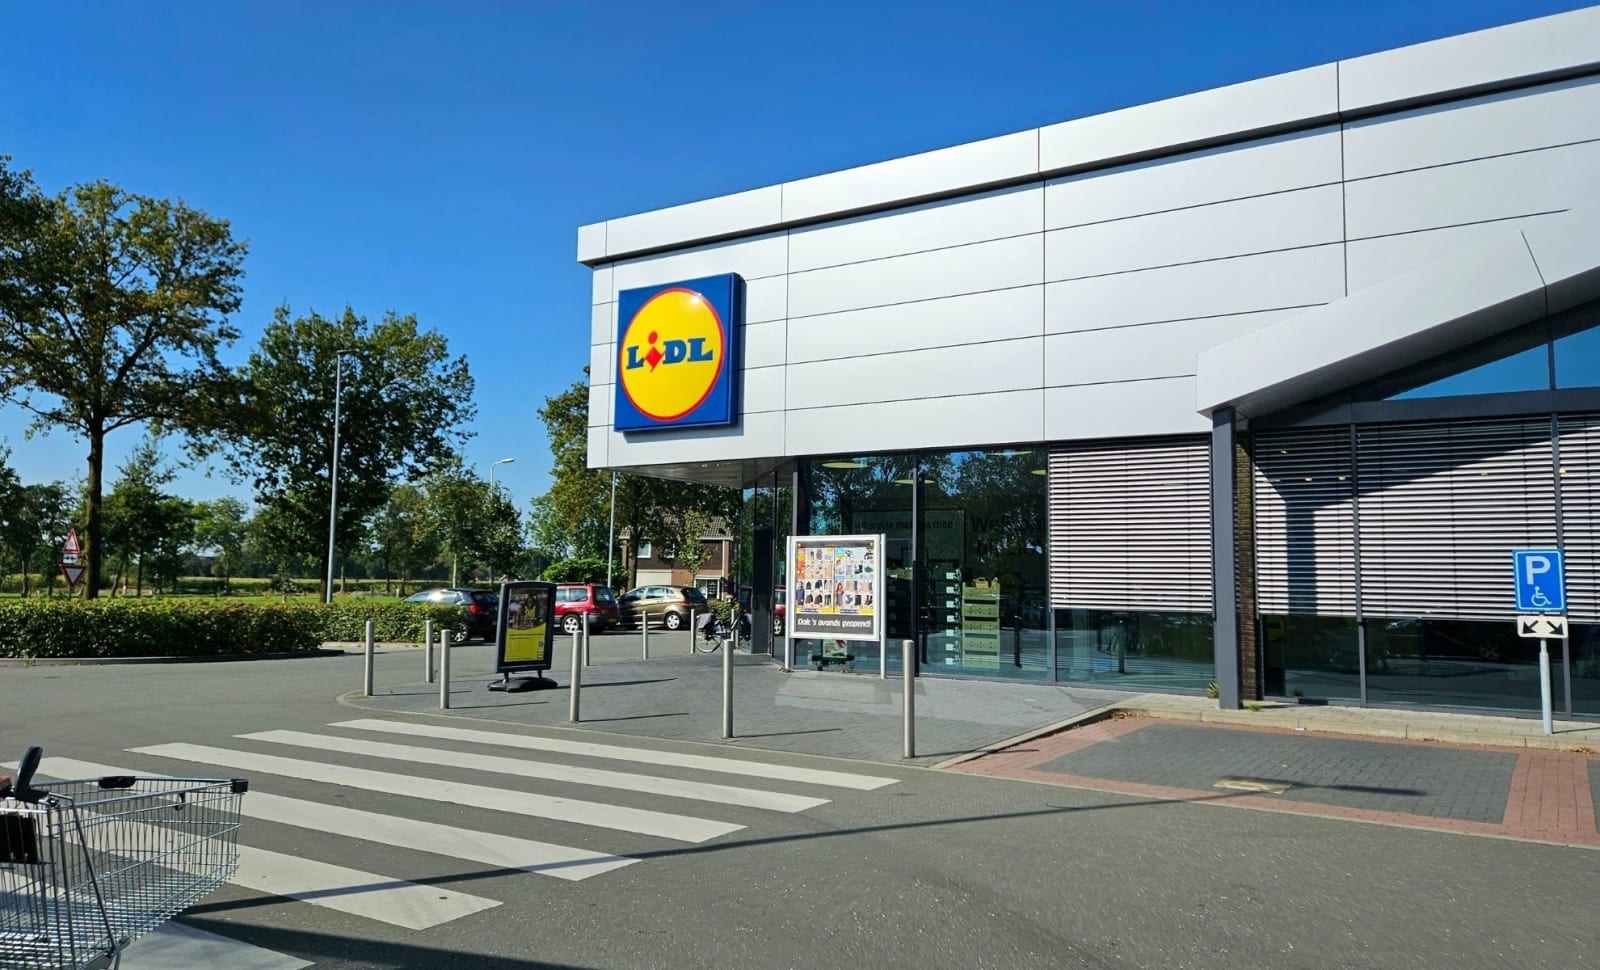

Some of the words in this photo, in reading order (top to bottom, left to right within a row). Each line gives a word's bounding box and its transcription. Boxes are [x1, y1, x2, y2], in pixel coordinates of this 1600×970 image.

[1525, 555, 1551, 585] P
[797, 618, 811, 626] Ook
[817, 619, 841, 627] avonds
